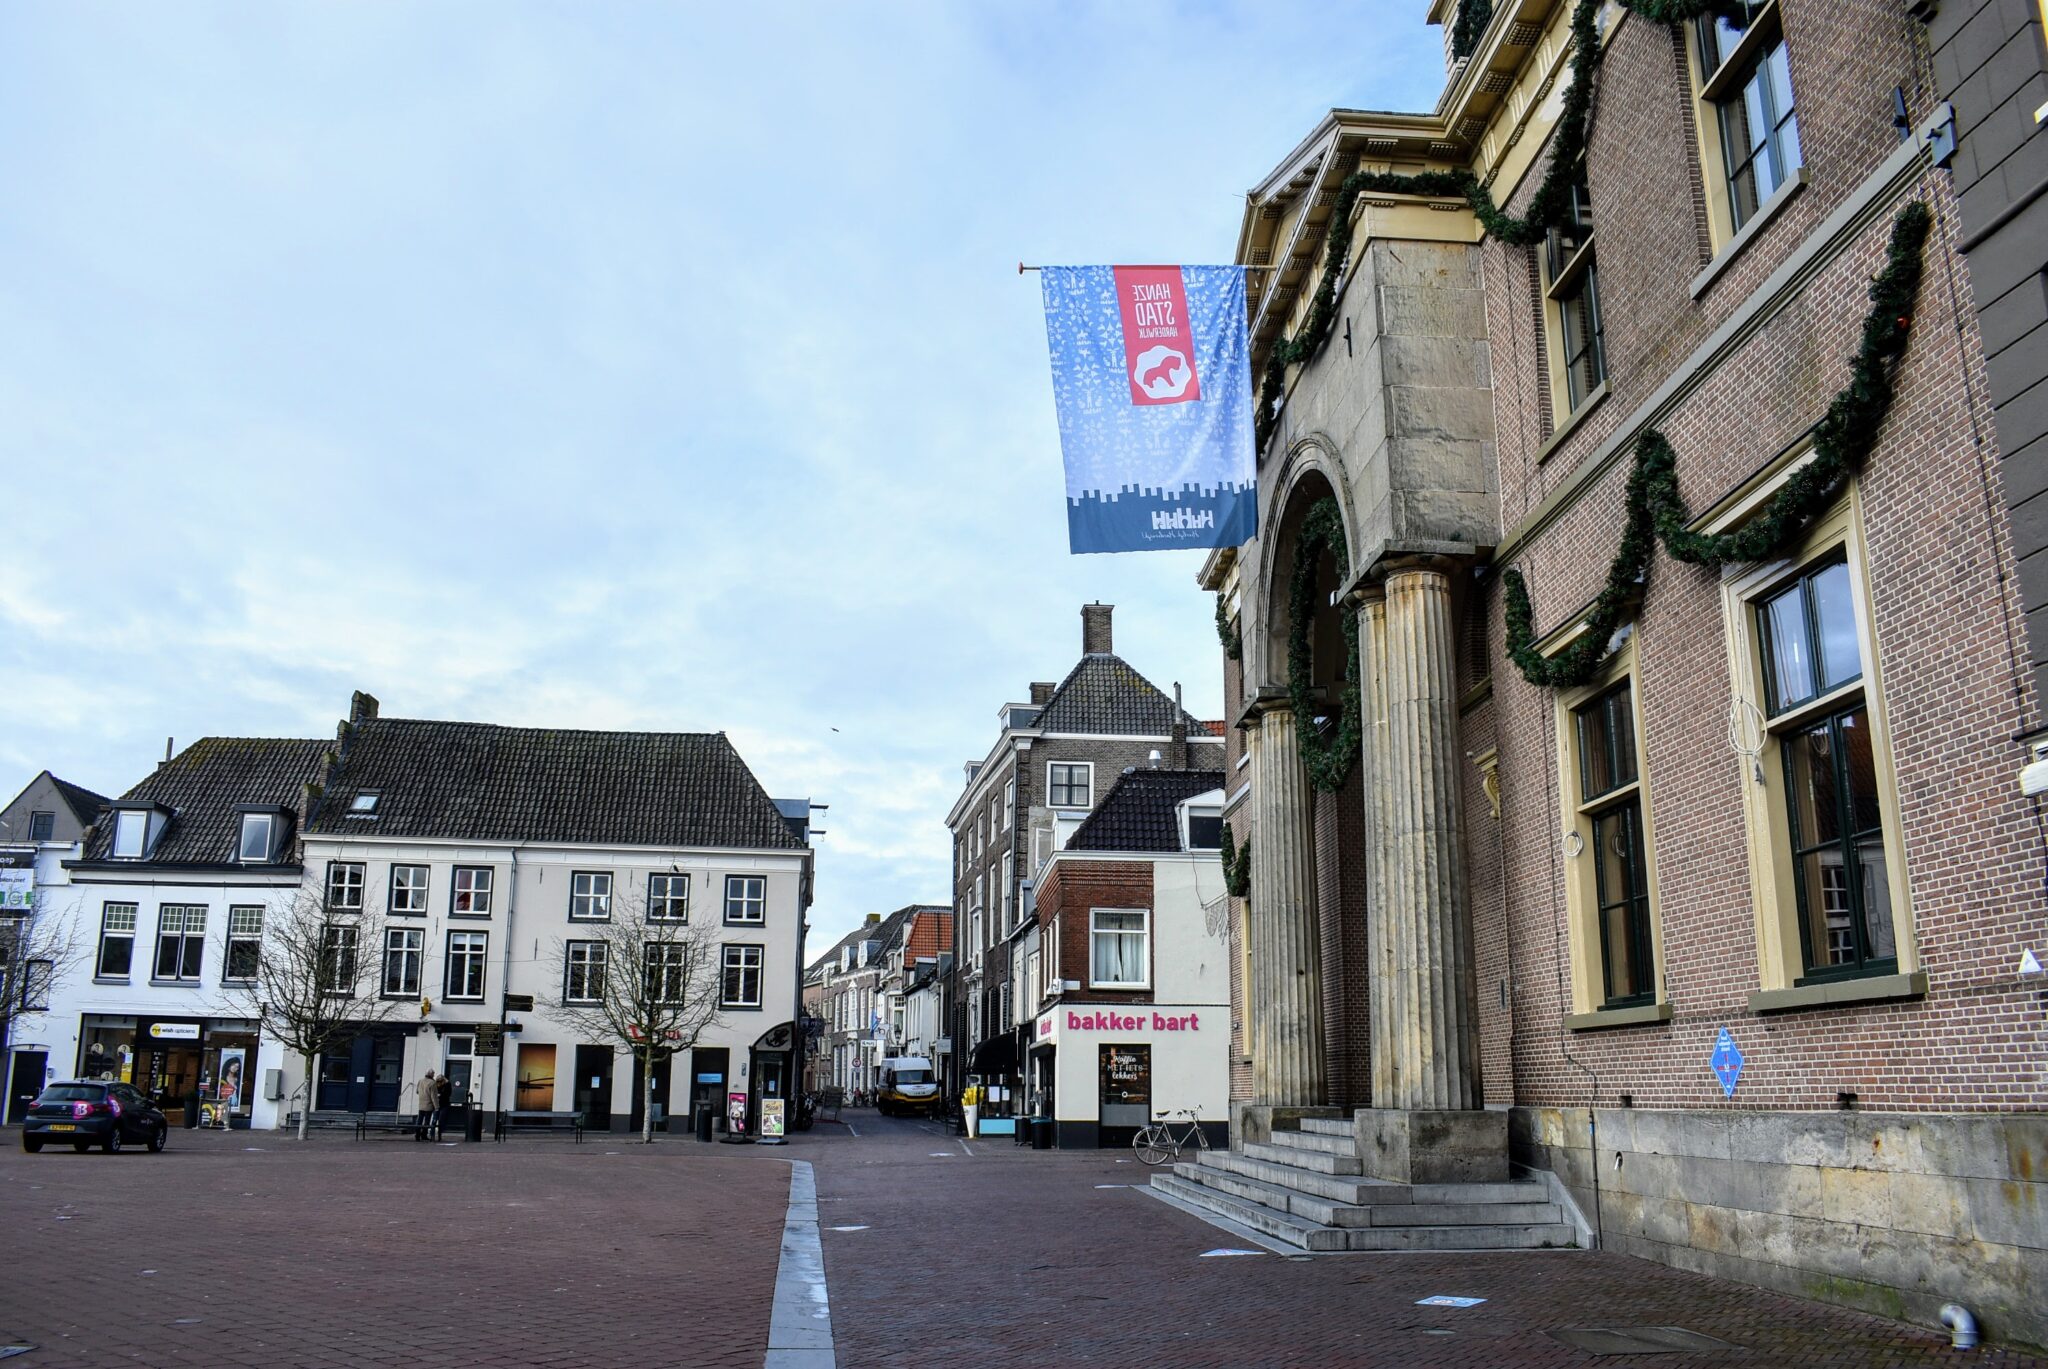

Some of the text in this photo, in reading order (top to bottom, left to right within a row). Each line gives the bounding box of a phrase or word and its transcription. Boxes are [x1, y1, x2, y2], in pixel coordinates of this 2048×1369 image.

[1067, 1011, 1147, 1031] bakker
[1152, 1011, 1200, 1031] bart
[1113, 1055, 1137, 1065] Koffie
[1111, 1071, 1138, 1081] lekkers
